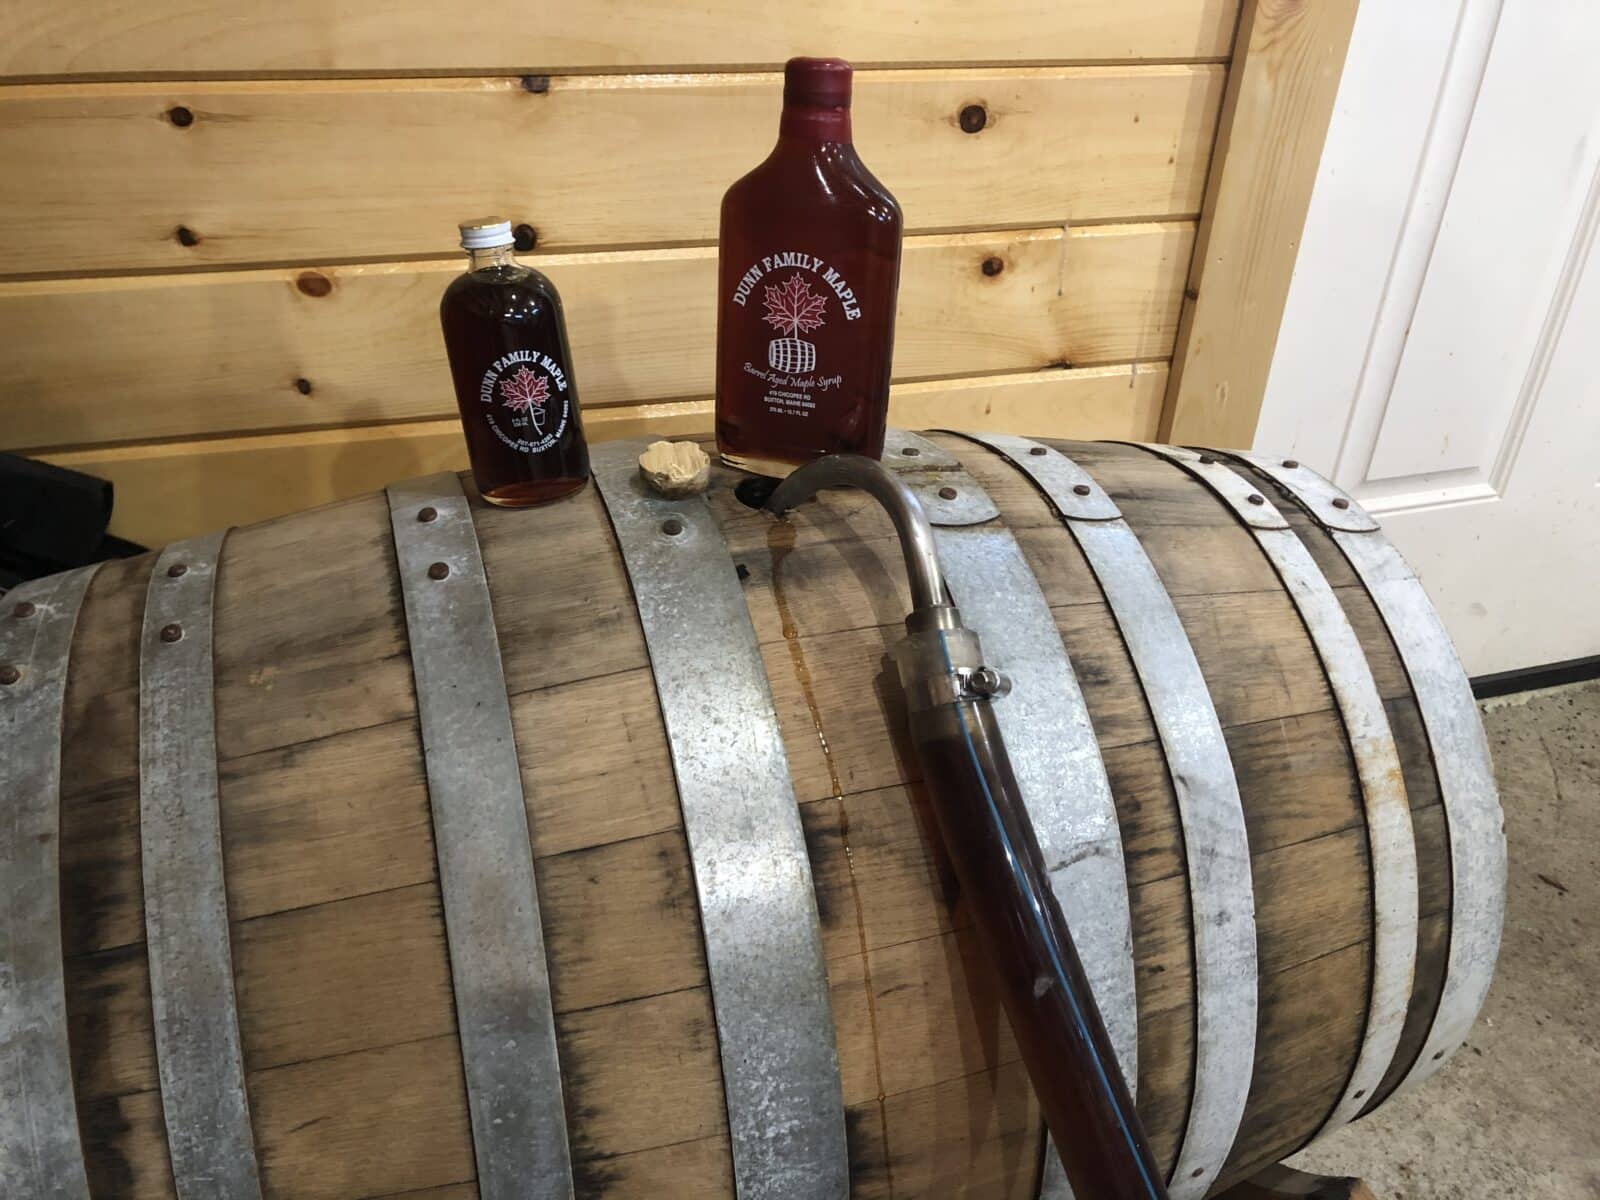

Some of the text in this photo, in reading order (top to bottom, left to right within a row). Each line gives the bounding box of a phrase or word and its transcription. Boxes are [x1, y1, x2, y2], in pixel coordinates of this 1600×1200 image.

[733, 252, 861, 320] DUNN FAMILY MAPLE
[481, 350, 567, 402] DUNN FAMILY MAPLE
[744, 362, 842, 392] Barrel Aged Maple Syrup
